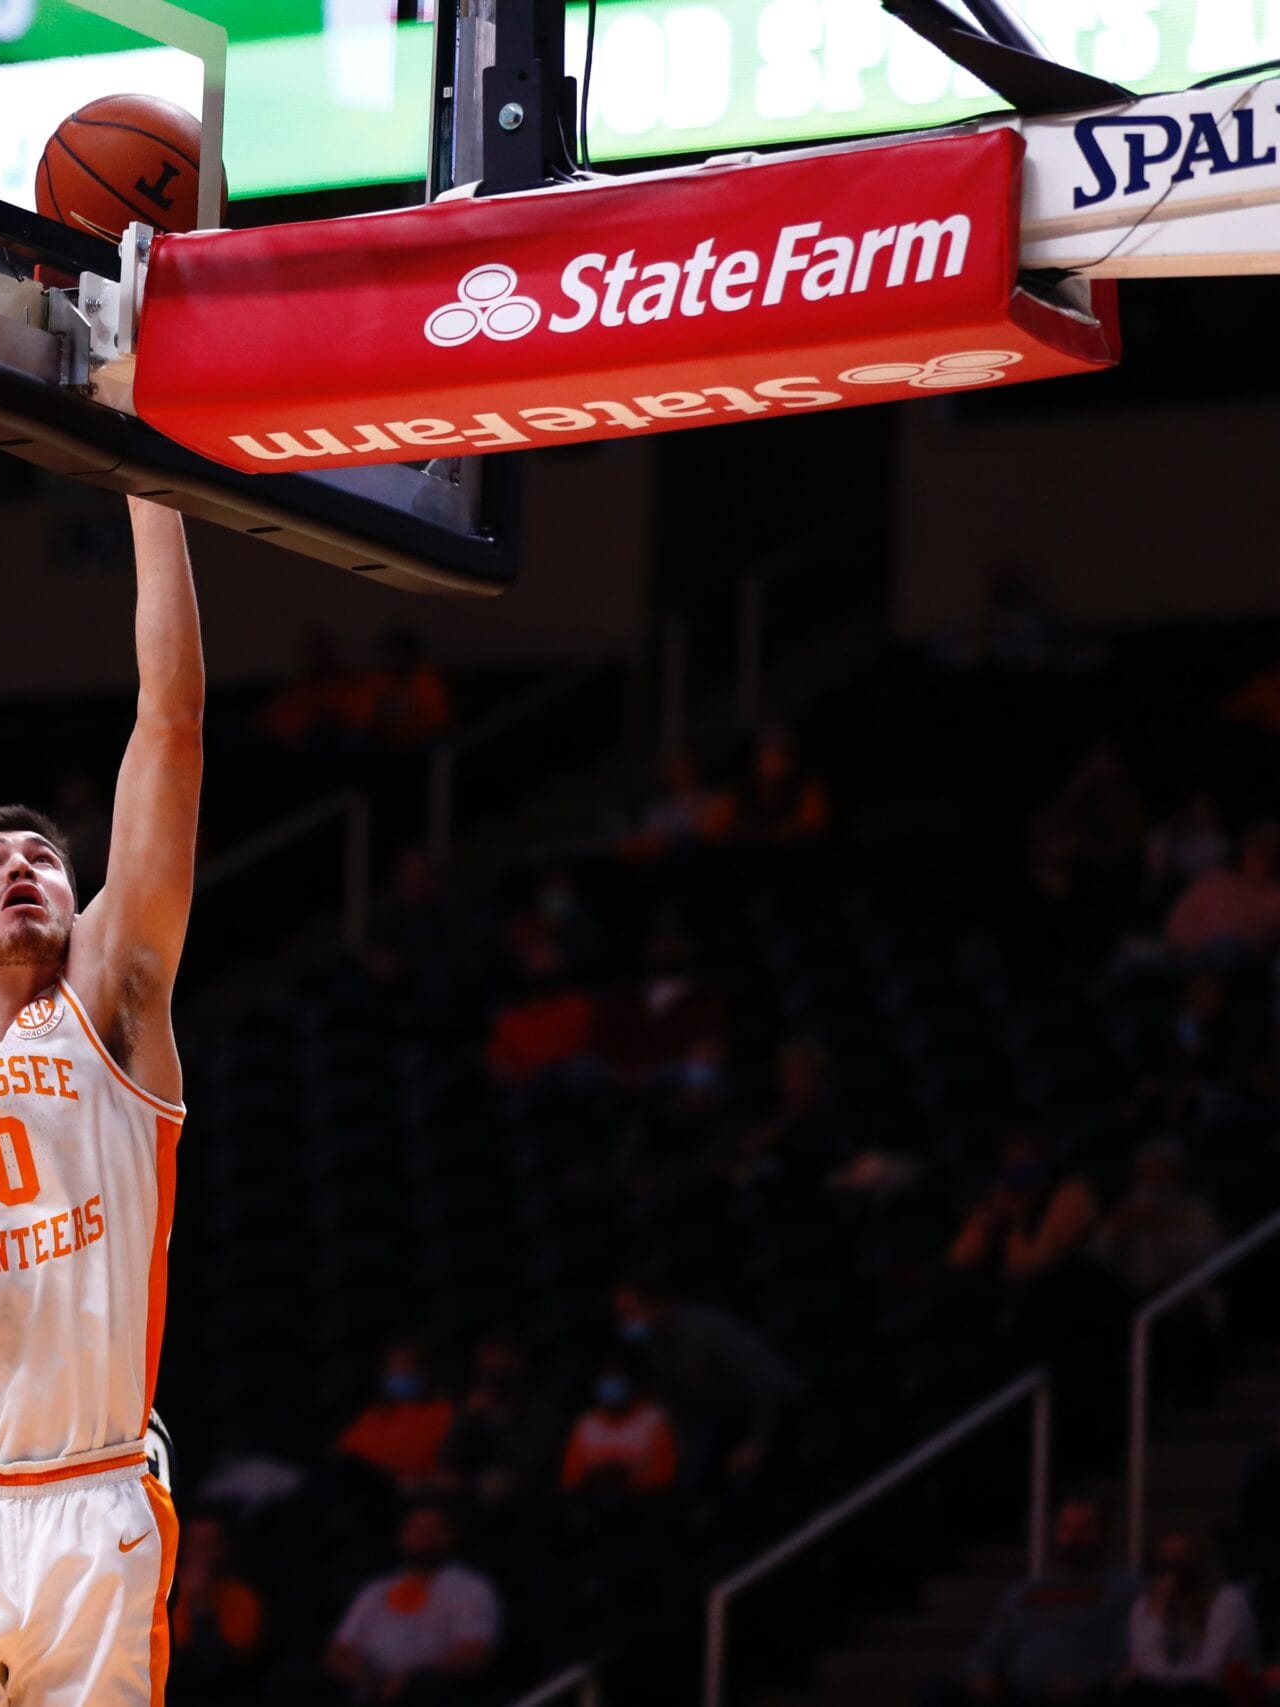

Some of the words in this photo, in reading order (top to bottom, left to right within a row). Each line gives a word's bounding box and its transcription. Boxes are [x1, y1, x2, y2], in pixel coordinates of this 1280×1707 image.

[1073, 104, 1280, 210] SPAL
[133, 160, 182, 212] T
[19, 1015, 60, 1038] GRADUATE
[20, 998, 53, 1028] SEC
